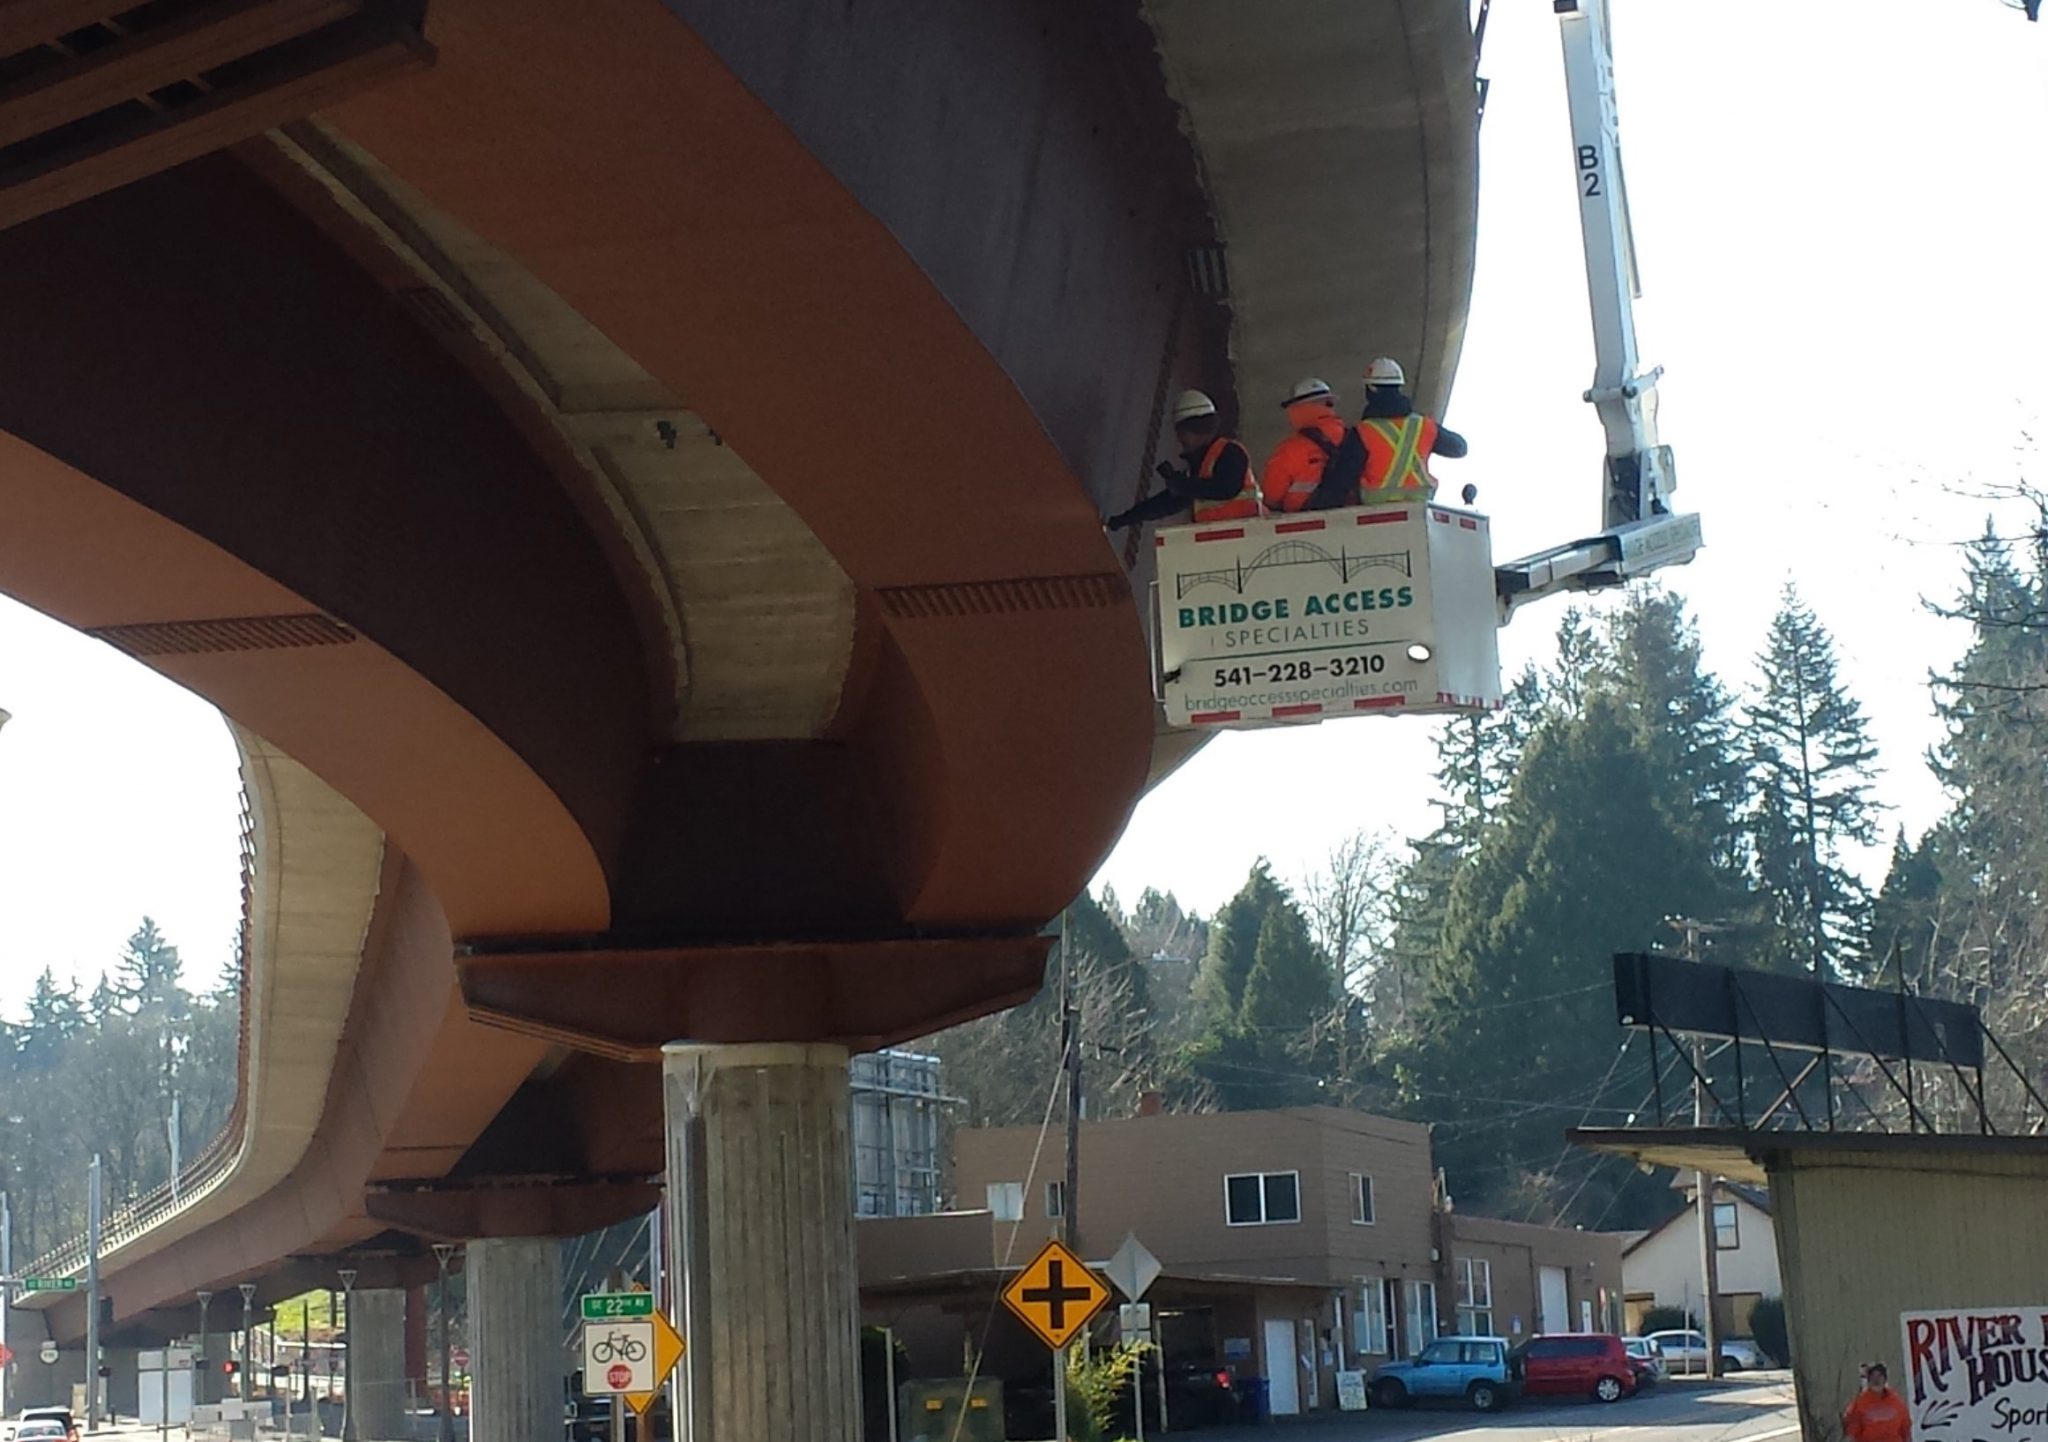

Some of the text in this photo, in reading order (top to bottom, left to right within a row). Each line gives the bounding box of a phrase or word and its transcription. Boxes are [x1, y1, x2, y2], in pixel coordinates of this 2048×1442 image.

[1578, 145, 1598, 170] B
[1584, 172, 1601, 197] 2
[1179, 586, 1414, 628] BRIDGE ACCESS
[1225, 619, 1370, 648] SPECIALTIES
[1214, 654, 1385, 688] 541-228-3210
[1907, 1314, 2026, 1407] RIVER
[1991, 1397, 2048, 1434] Spor
